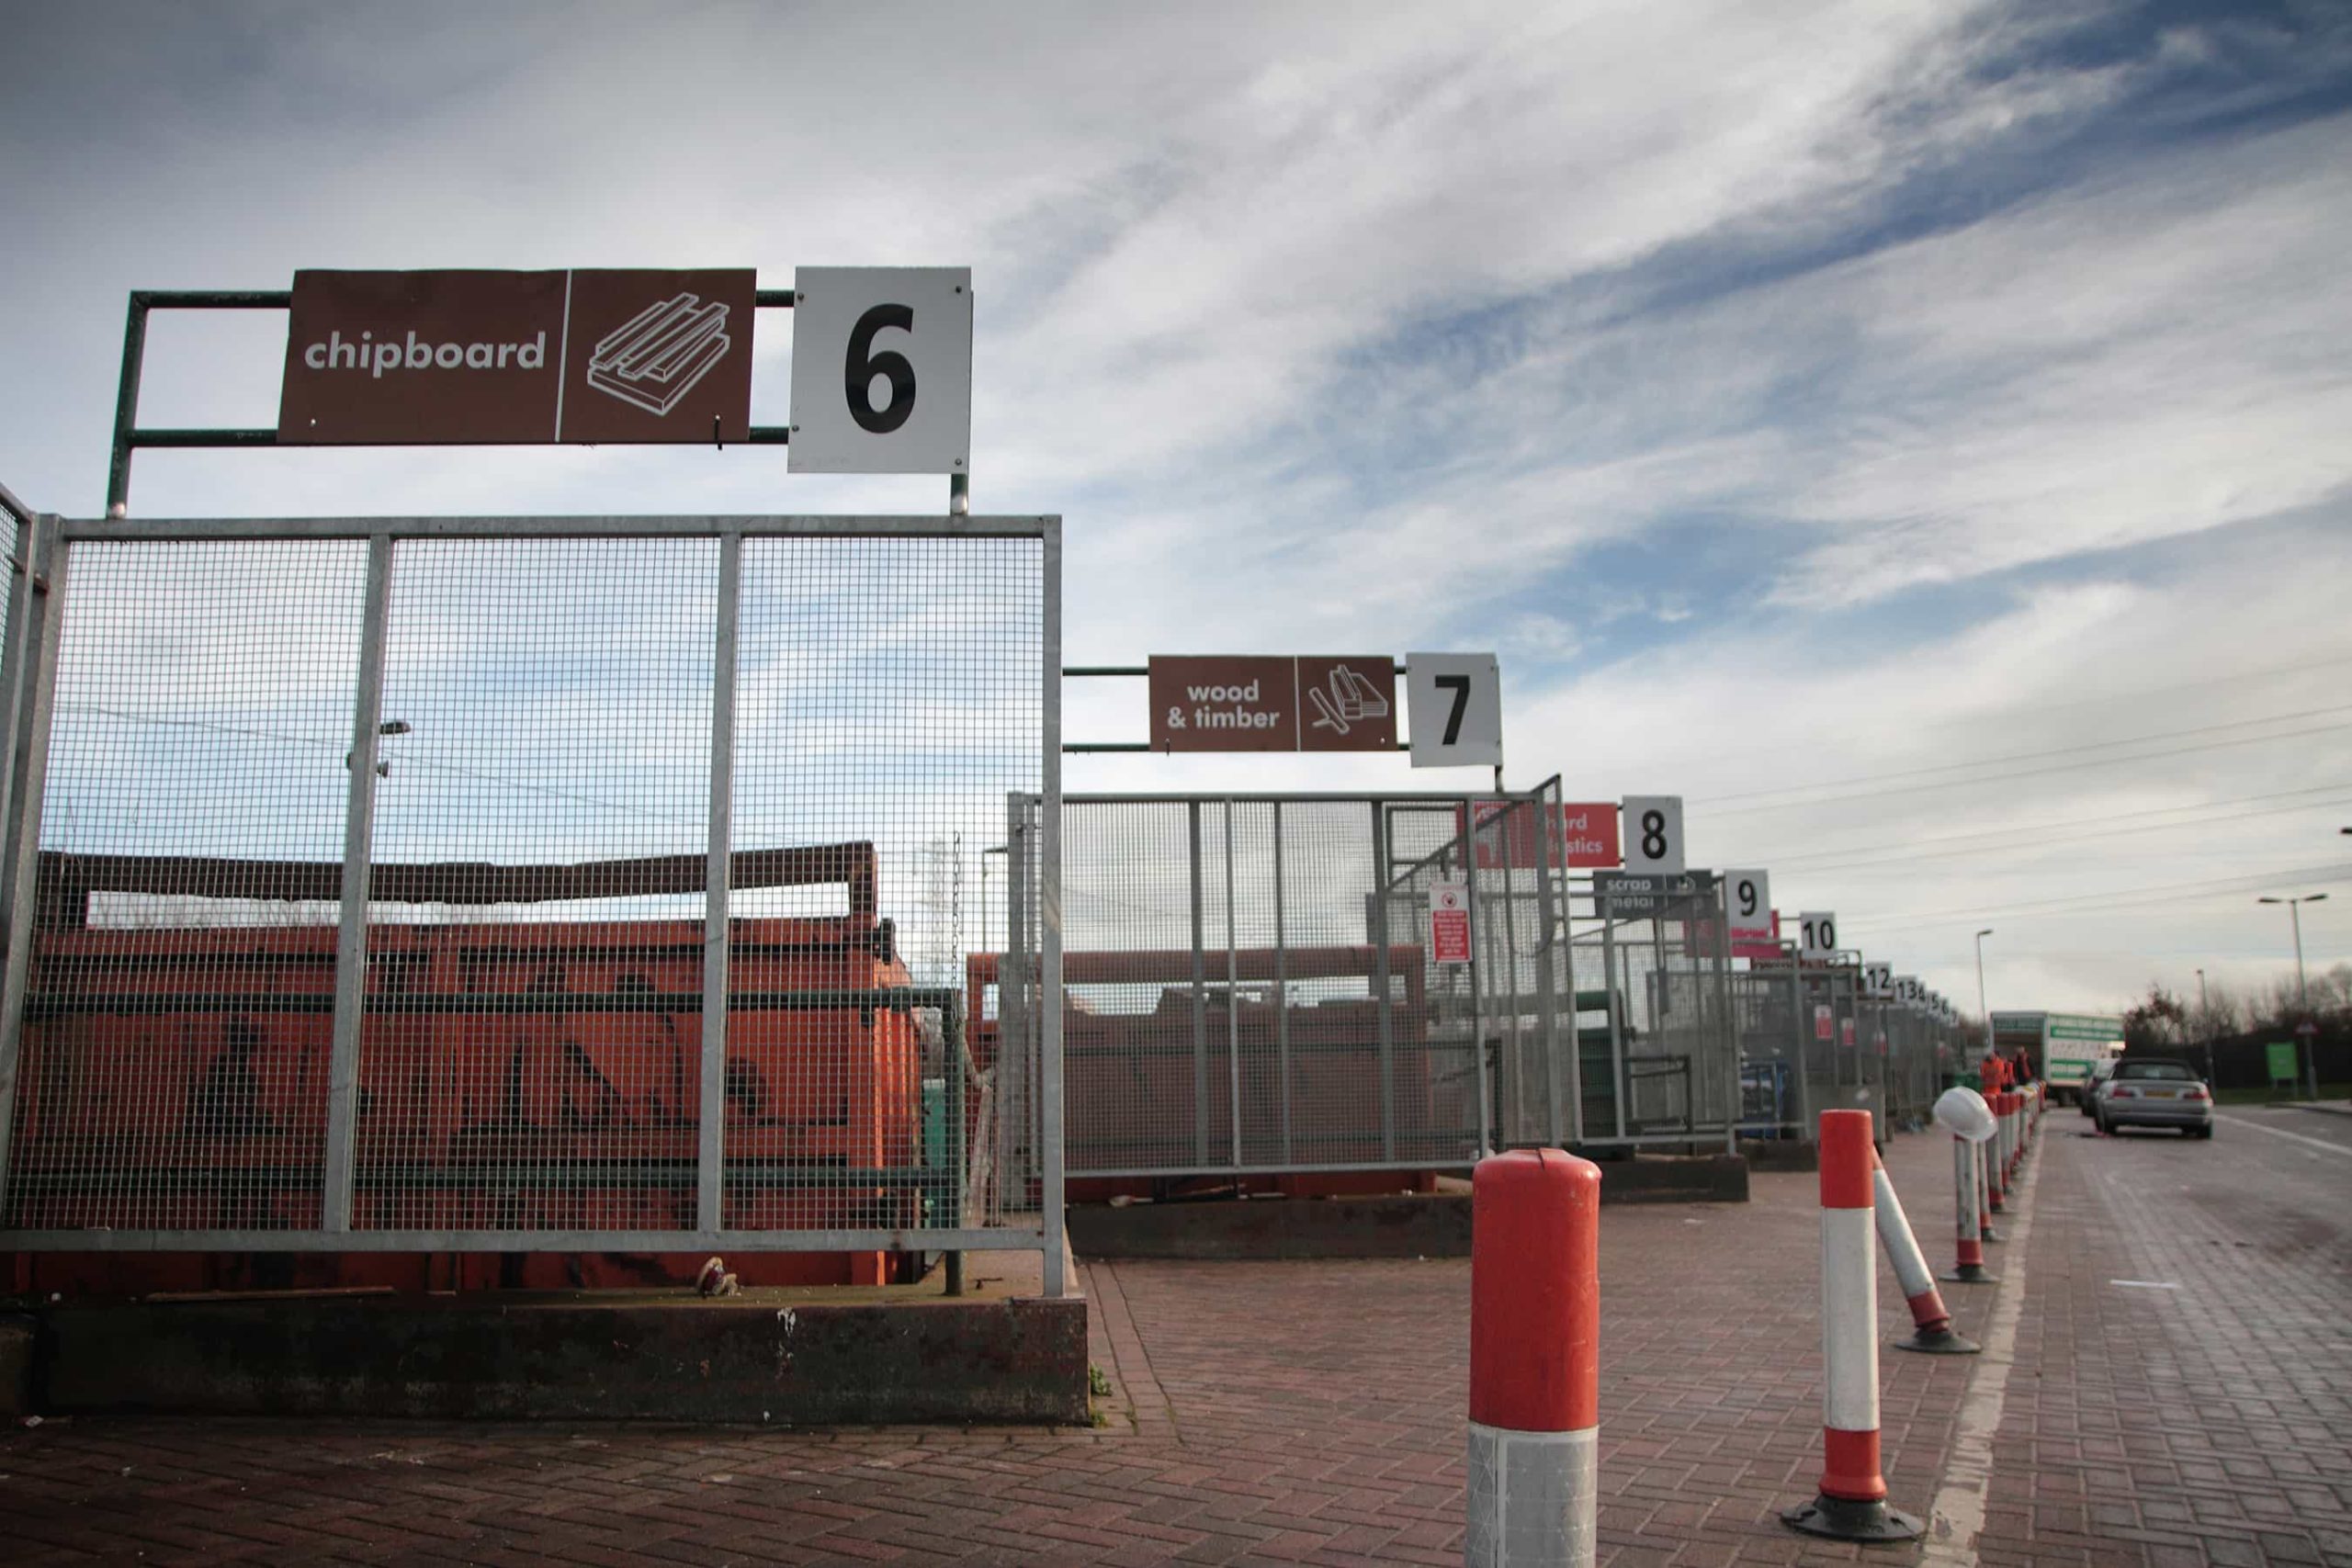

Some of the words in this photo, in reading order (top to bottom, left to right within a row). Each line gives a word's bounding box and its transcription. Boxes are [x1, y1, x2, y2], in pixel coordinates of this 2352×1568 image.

[305, 332, 546, 378] chipboard
[845, 303, 917, 434] 6
[1188, 680, 1259, 702] wood
[1167, 705, 1186, 728] &
[1194, 705, 1281, 728] timber
[1435, 675, 1470, 745] 7
[1642, 809, 1667, 860] 8
[1738, 879, 1757, 917] 9
[1804, 919, 1834, 950] 10
[1868, 967, 1890, 989] 12
[1898, 980, 1917, 999] 13
